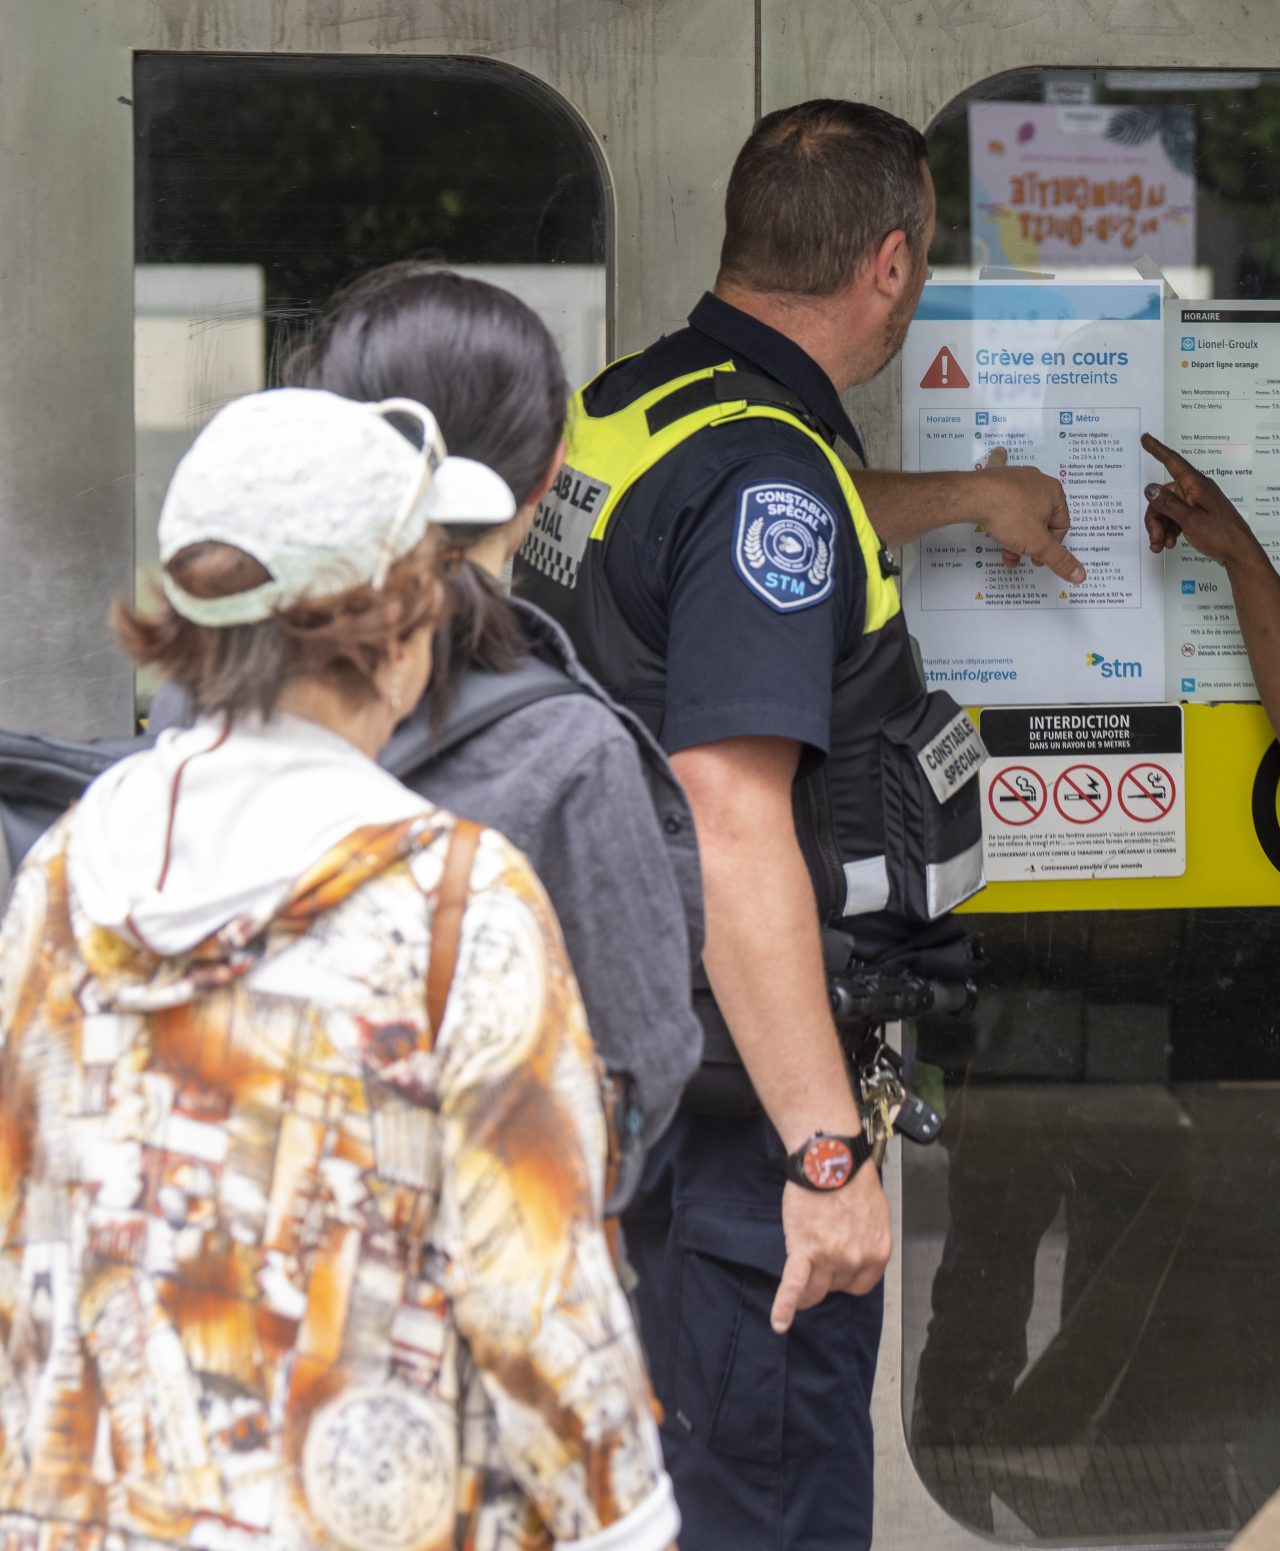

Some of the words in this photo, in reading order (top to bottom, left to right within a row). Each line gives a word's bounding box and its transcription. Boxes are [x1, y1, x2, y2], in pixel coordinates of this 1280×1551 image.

[1184, 312, 1221, 321] HORAIRE
[1198, 339, 1259, 349] Lionel-Groulx
[975, 348, 1034, 366] Grève
[1041, 352, 1065, 366] en
[1072, 351, 1129, 366] cours
[1191, 360, 1215, 370] Départ
[1216, 360, 1234, 370] ligne
[1235, 362, 1259, 370] orange
[978, 370, 1041, 385] Horaires
[1046, 370, 1118, 385] restreints
[1194, 389, 1230, 397] Montmorency
[926, 415, 961, 423] Horaires
[992, 415, 1007, 423] Bus
[1076, 414, 1100, 422] Métro
[1194, 434, 1230, 442] Montmorency
[1216, 468, 1234, 477] ligne
[755, 490, 829, 526] CONSTABLE
[767, 502, 819, 532] SPÉCIAL
[764, 571, 806, 596] STM
[1198, 581, 1218, 592] Vélo
[966, 656, 1014, 666] déplacements
[1100, 658, 1143, 679] stm
[923, 668, 1017, 683] stm.info/greve
[1029, 714, 1131, 730] INTERDICTION
[1029, 731, 1041, 741] DE
[1043, 730, 1074, 740] FUMER
[1075, 730, 1088, 740] OU
[1090, 729, 1130, 739] VAPOTER
[926, 718, 974, 770] CONSTABLE
[1029, 741, 1049, 750] DANS
[1050, 741, 1061, 749] UN
[1062, 740, 1086, 749] RAYON
[1087, 740, 1097, 748] DE
[1097, 740, 1103, 748] 9
[1103, 737, 1131, 748] MÈTRES
